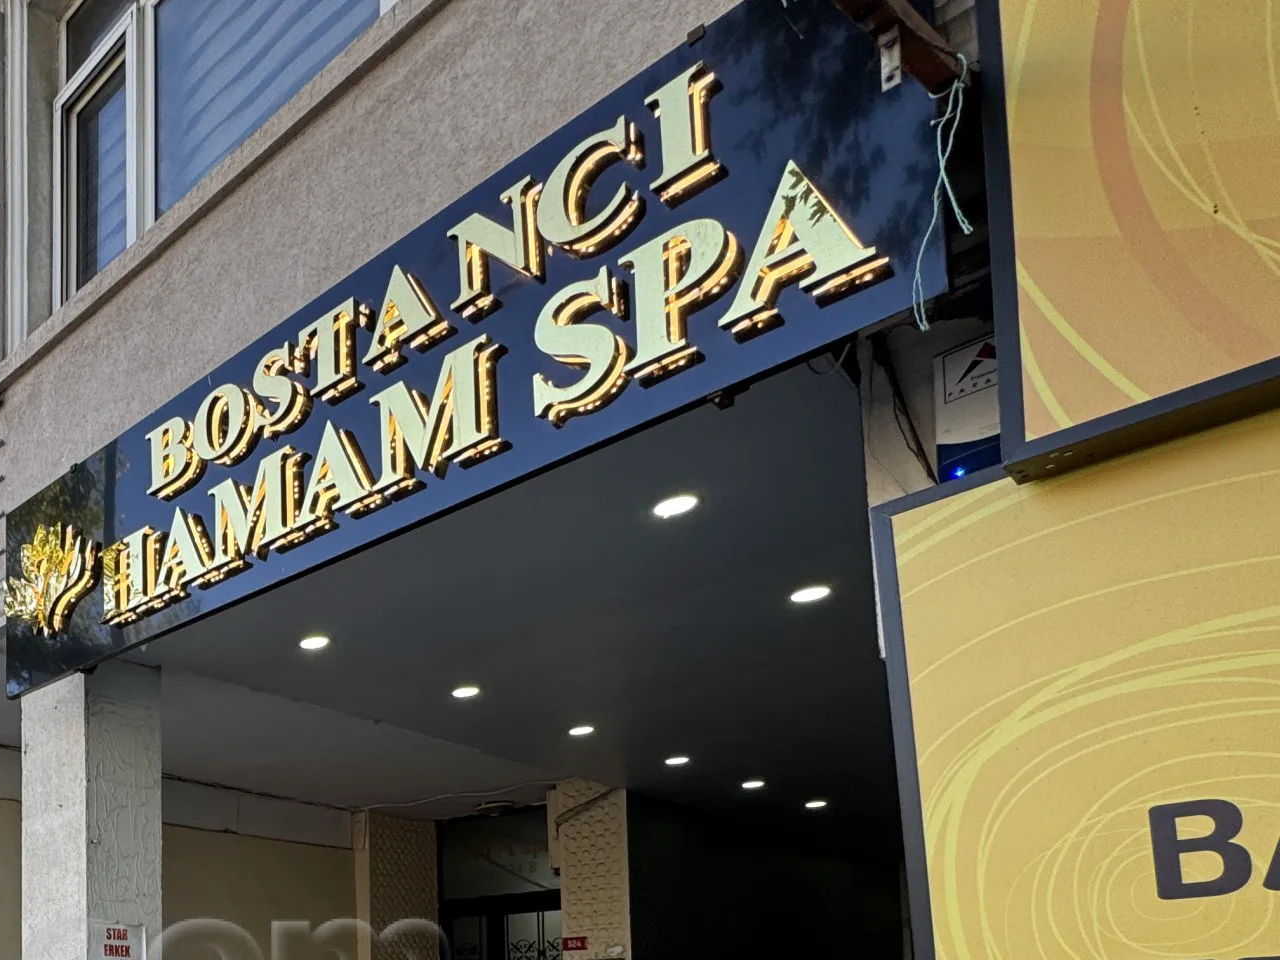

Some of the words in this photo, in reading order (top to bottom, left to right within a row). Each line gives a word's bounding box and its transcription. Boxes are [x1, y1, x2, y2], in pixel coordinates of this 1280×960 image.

[145, 60, 722, 502] BOSTANCI
[101, 334, 511, 627] HAMAM
[533, 159, 890, 429] SPA
[1148, 799, 1280, 900] B
[104, 944, 131, 957] ERKEK
[106, 927, 128, 940] STAR
